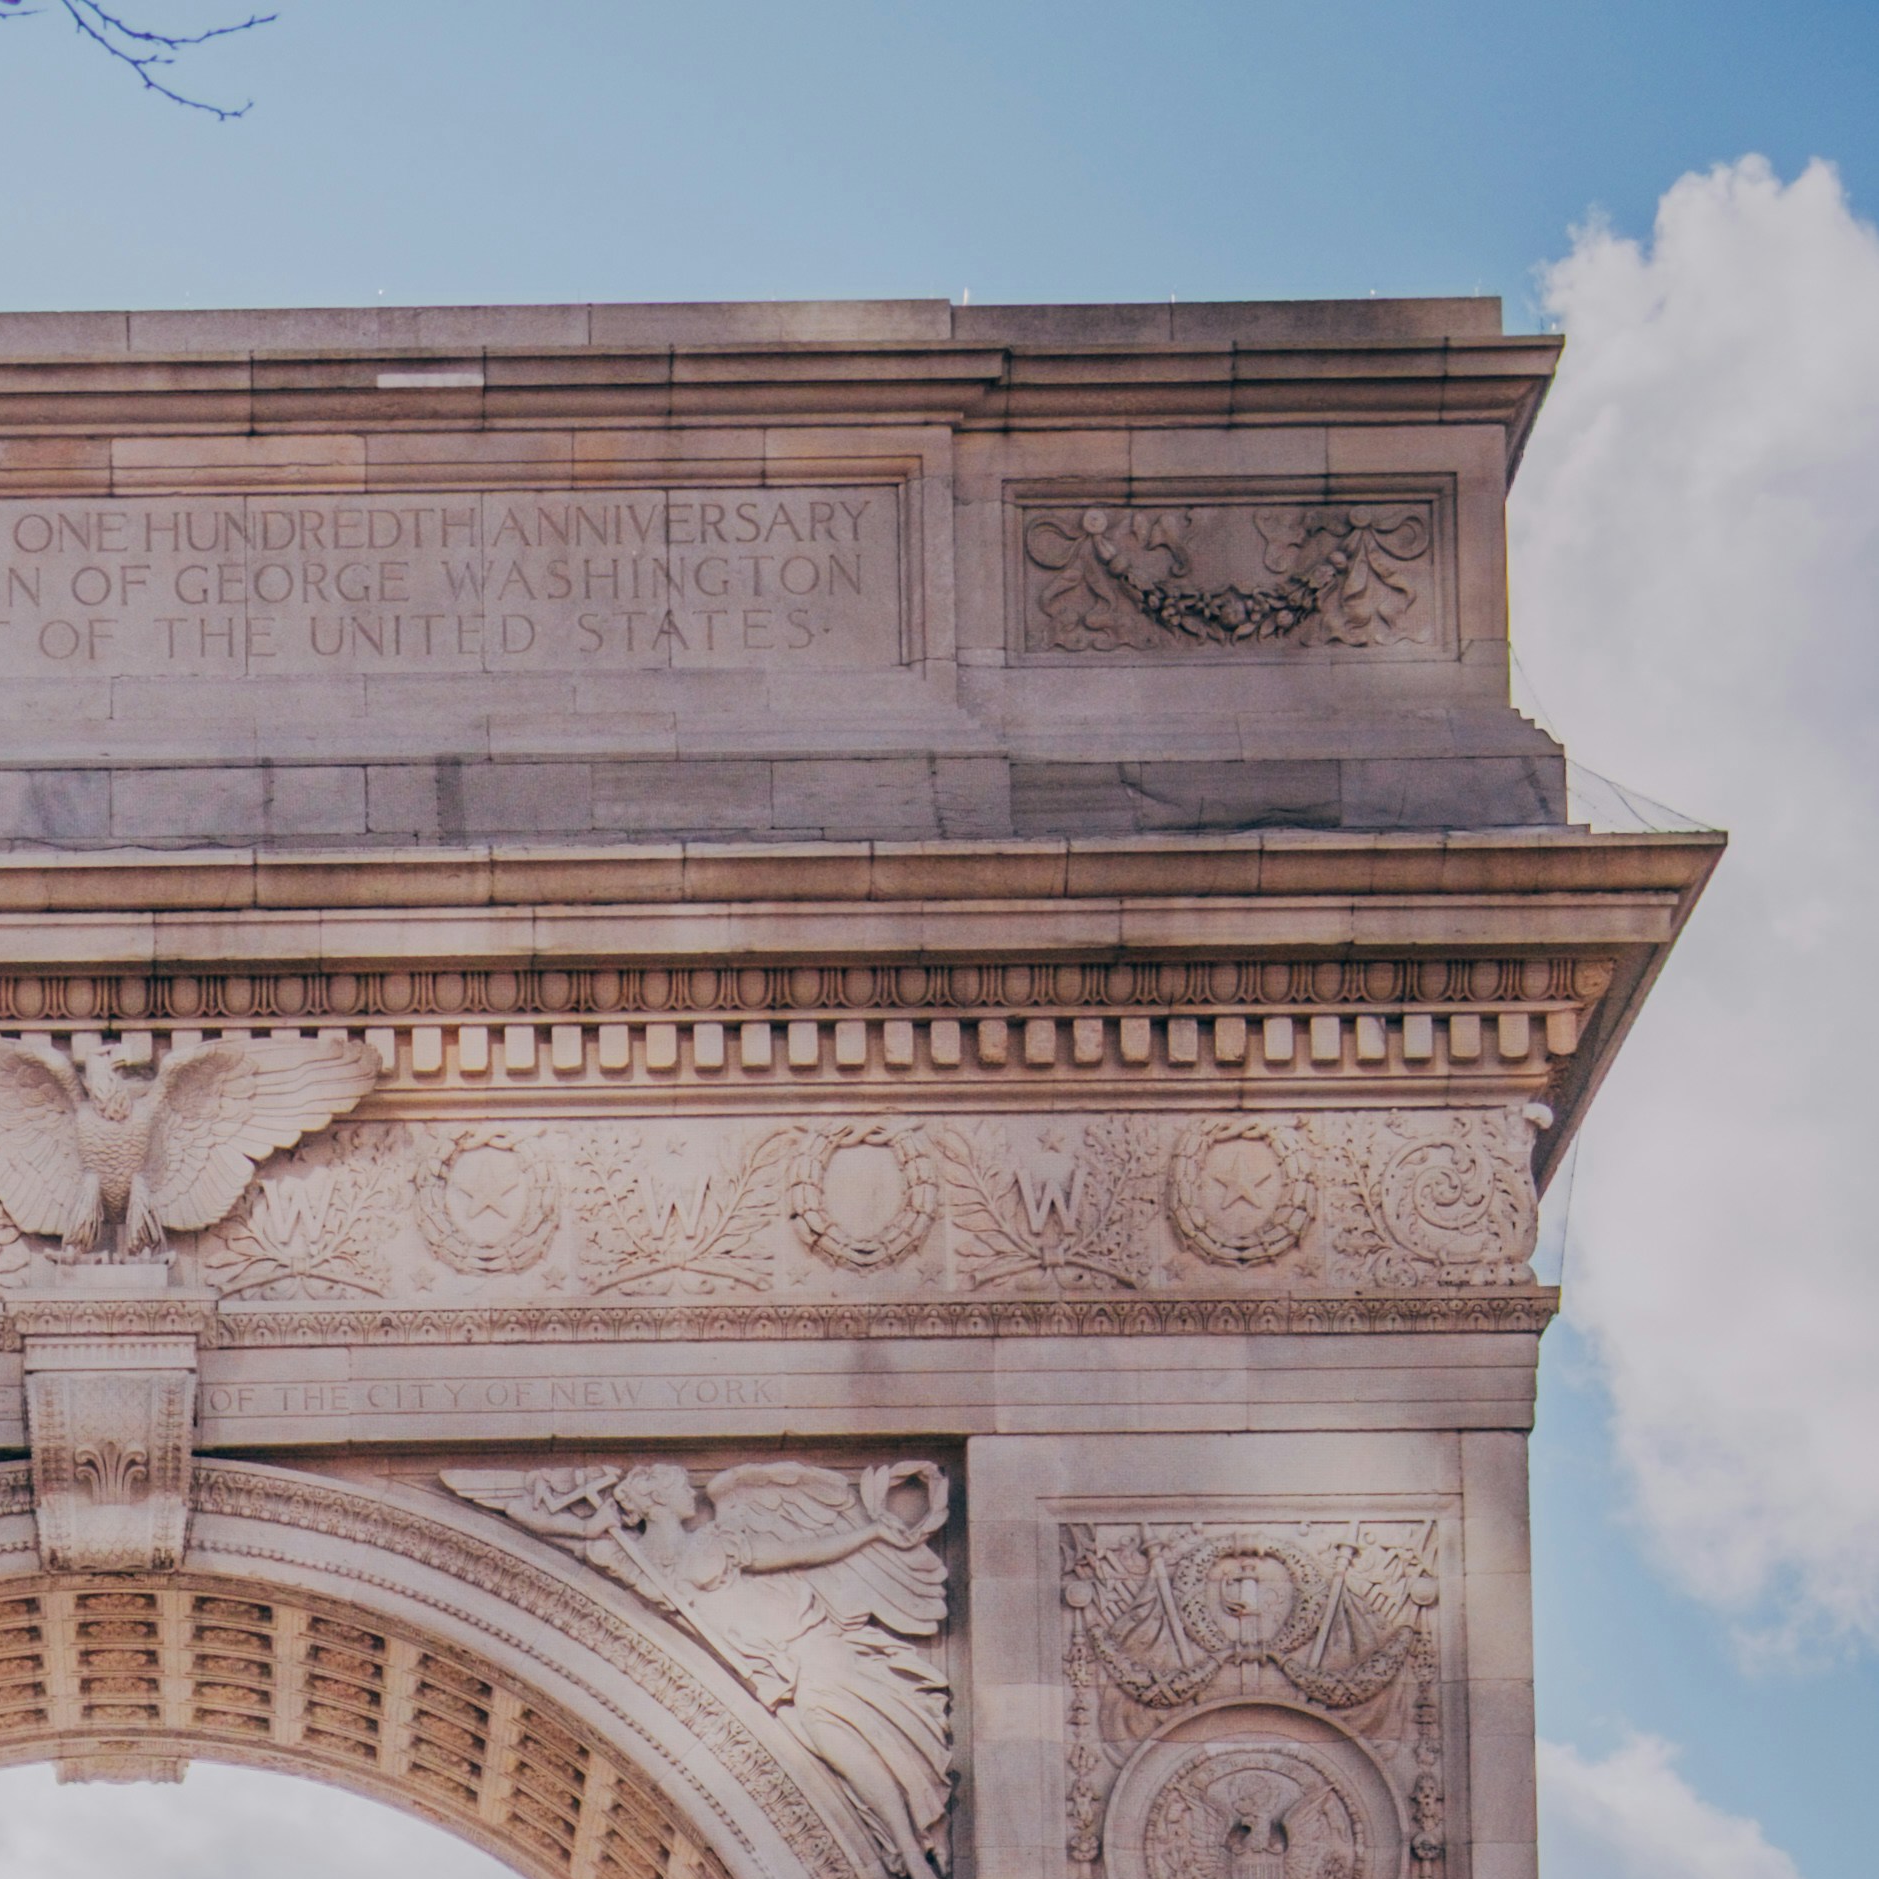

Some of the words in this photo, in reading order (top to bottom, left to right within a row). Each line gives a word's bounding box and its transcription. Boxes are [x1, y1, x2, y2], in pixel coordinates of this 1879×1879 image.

[12, 511, 129, 555] ONE
[142, 506, 477, 554] HUNDREDTH
[492, 500, 872, 548] ANNIVERSARY
[70, 564, 151, 607] OF
[174, 560, 411, 605] GEORGE
[440, 553, 862, 602] WASHINGTON
[38, 618, 119, 662] OF
[153, 616, 277, 660] THE
[309, 612, 537, 658] UNITED
[209, 1387, 256, 1413] OF
[273, 1385, 351, 1412] THE
[366, 1383, 468, 1409] CITY
[485, 1381, 533, 1407] OF
[551, 1380, 645, 1406] NEW
[667, 1378, 775, 1405] YORK
